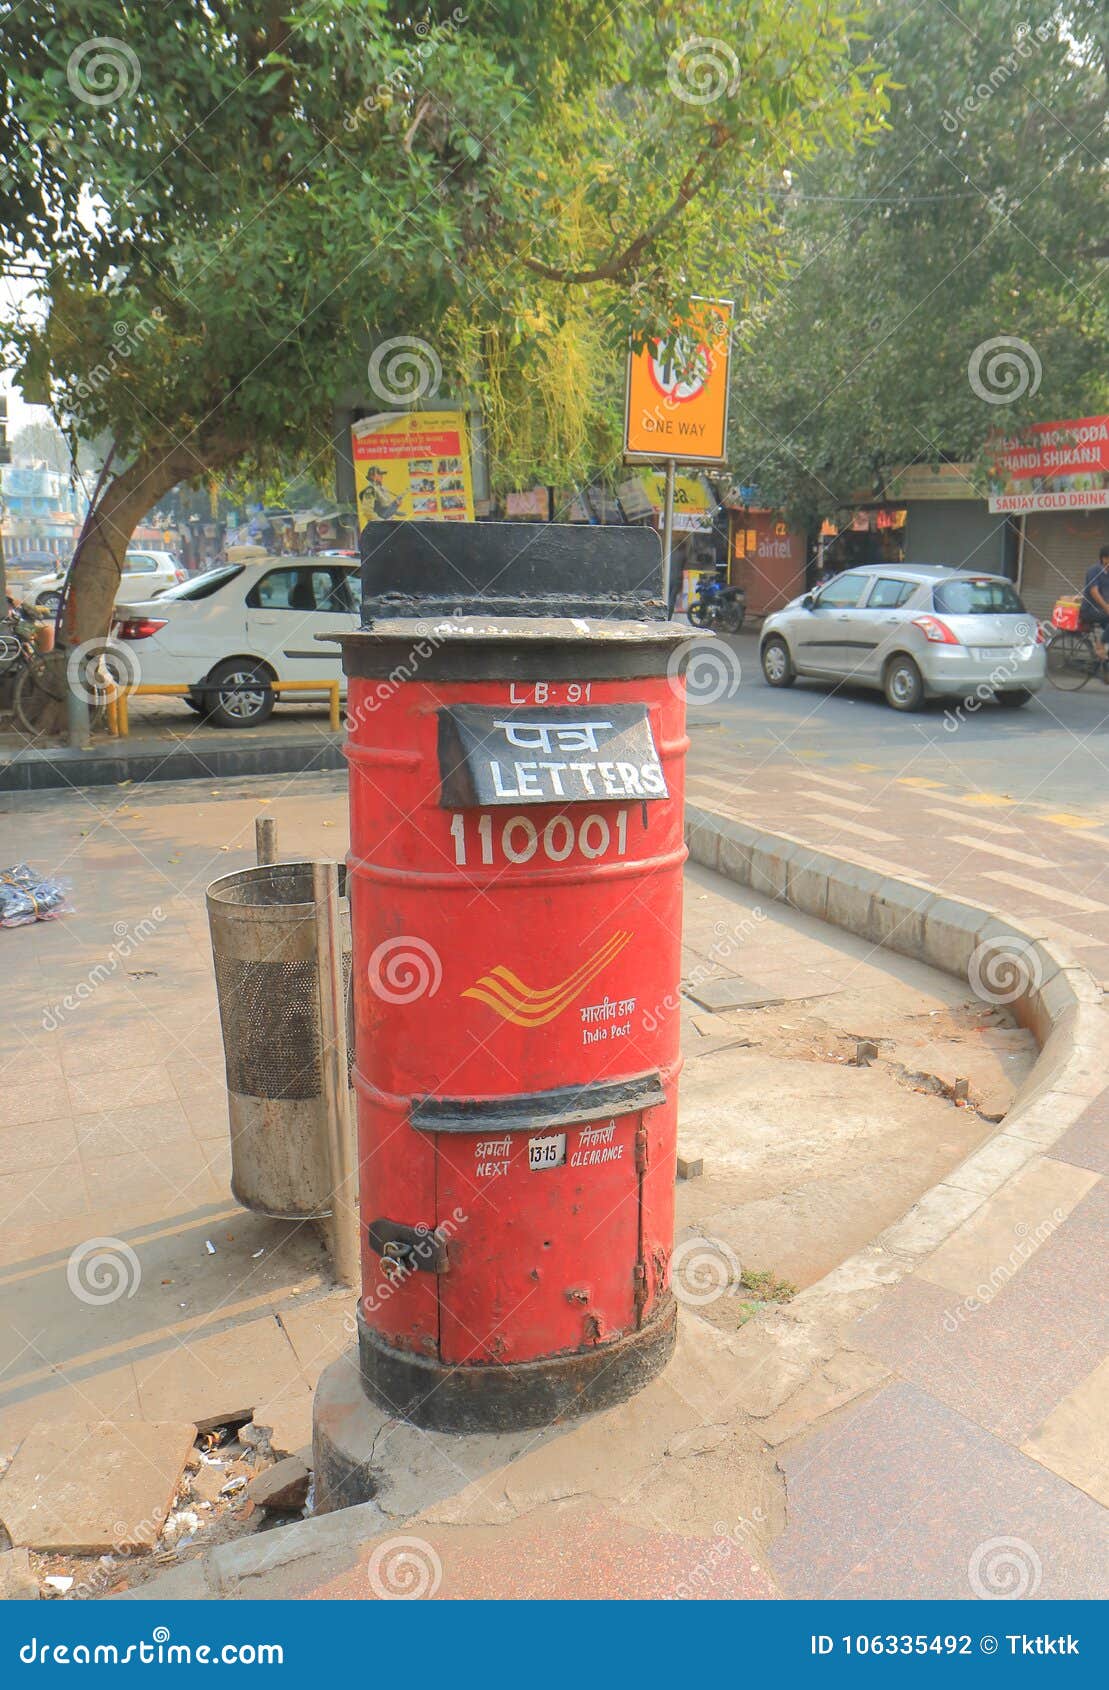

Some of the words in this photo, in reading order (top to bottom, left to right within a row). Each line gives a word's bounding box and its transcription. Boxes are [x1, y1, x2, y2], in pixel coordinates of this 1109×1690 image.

[646, 419, 673, 434] ONE
[678, 422, 706, 436] WAY
[1071, 424, 1108, 443] SODA
[1043, 447, 1101, 467] SHIKANJI
[996, 496, 1034, 511] SANJAY
[1038, 494, 1066, 508] COLD
[1069, 492, 1106, 506] DRINK
[758, 537, 792, 559] airtel
[493, 720, 613, 754] पत्र
[489, 761, 665, 797] LETTERS
[450, 810, 628, 866] 110001
[580, 996, 617, 1022] भारतीय
[618, 998, 636, 1017] डाक
[583, 1028, 607, 1045] India
[611, 1021, 631, 1039] Post
[579, 1120, 616, 1147] निकासी
[570, 1144, 624, 1167] CLEARANCE
[476, 1160, 511, 1177] NEXT
